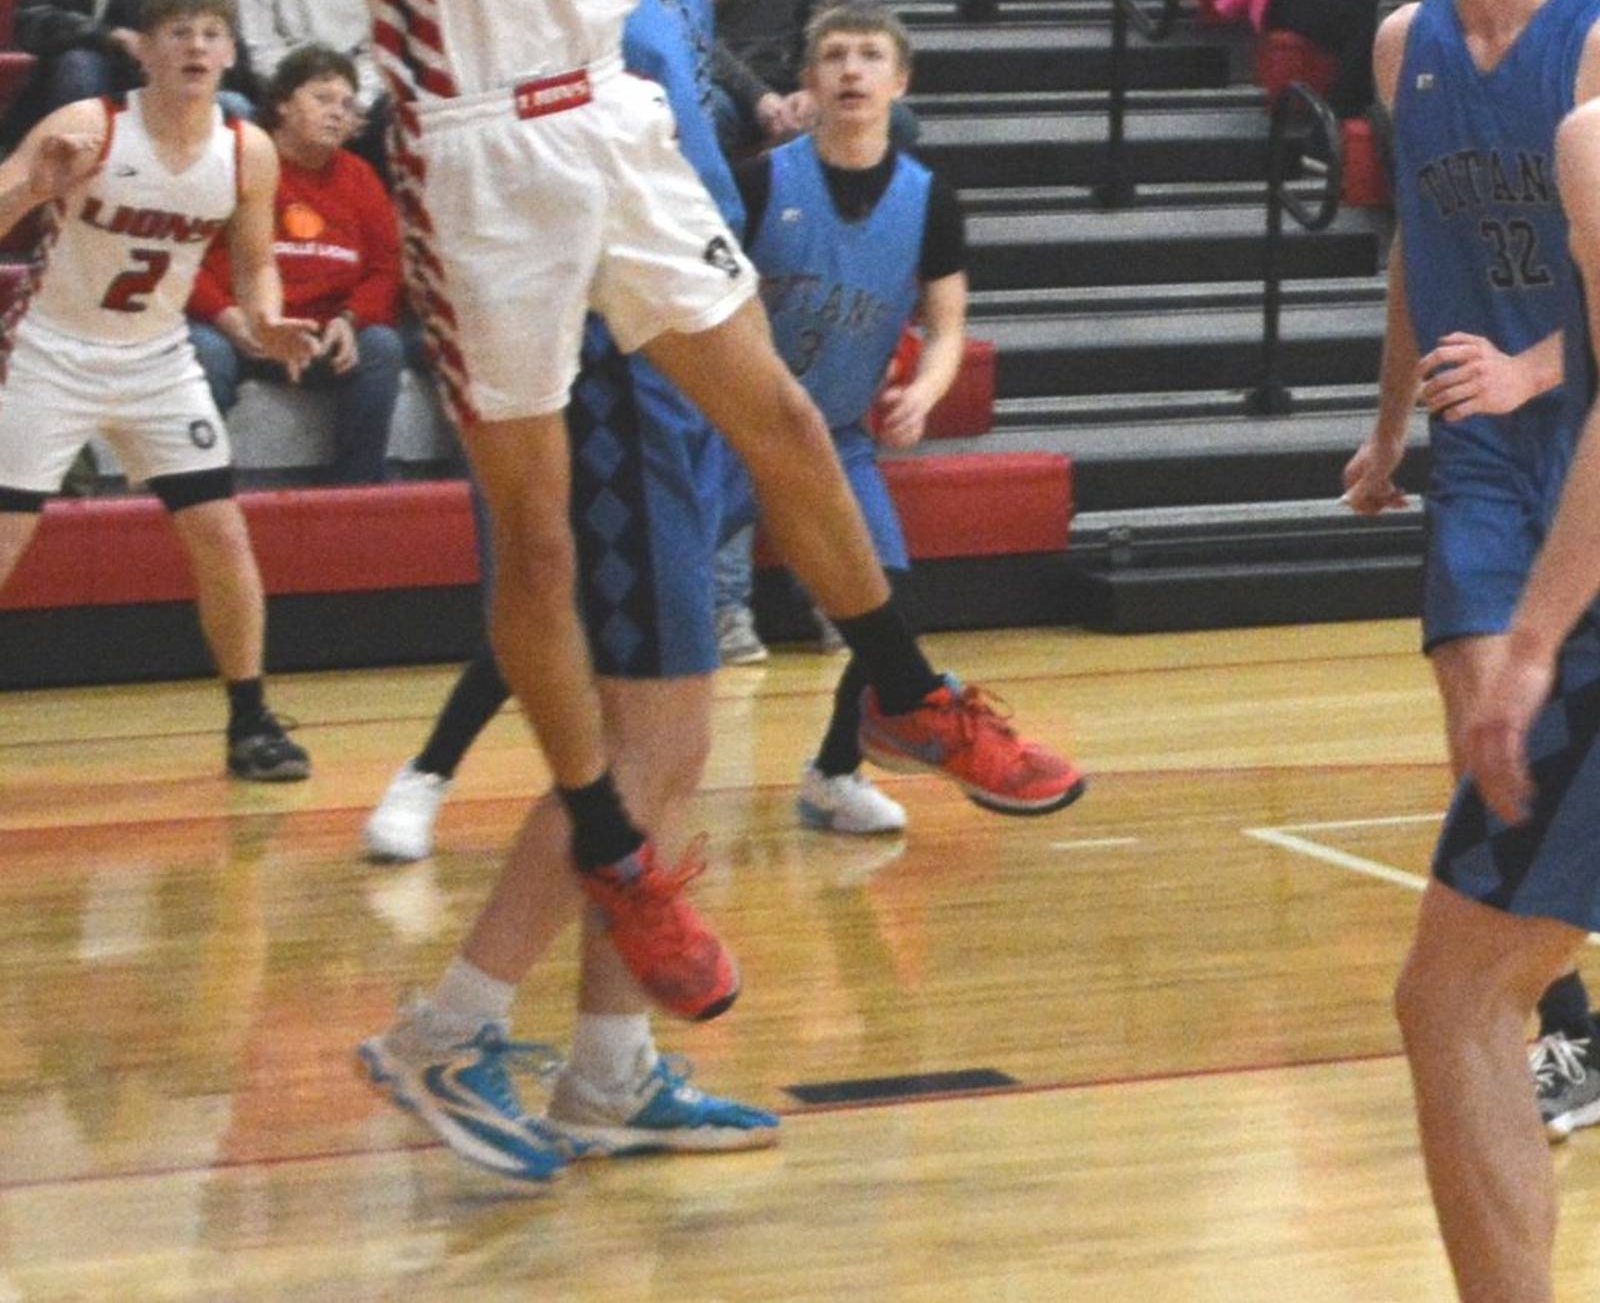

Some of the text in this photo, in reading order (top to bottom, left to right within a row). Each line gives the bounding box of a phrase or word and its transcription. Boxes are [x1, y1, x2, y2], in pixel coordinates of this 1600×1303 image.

[1416, 148, 1556, 219] TITAN
[100, 248, 171, 312] 2
[1479, 216, 1555, 290] 32
